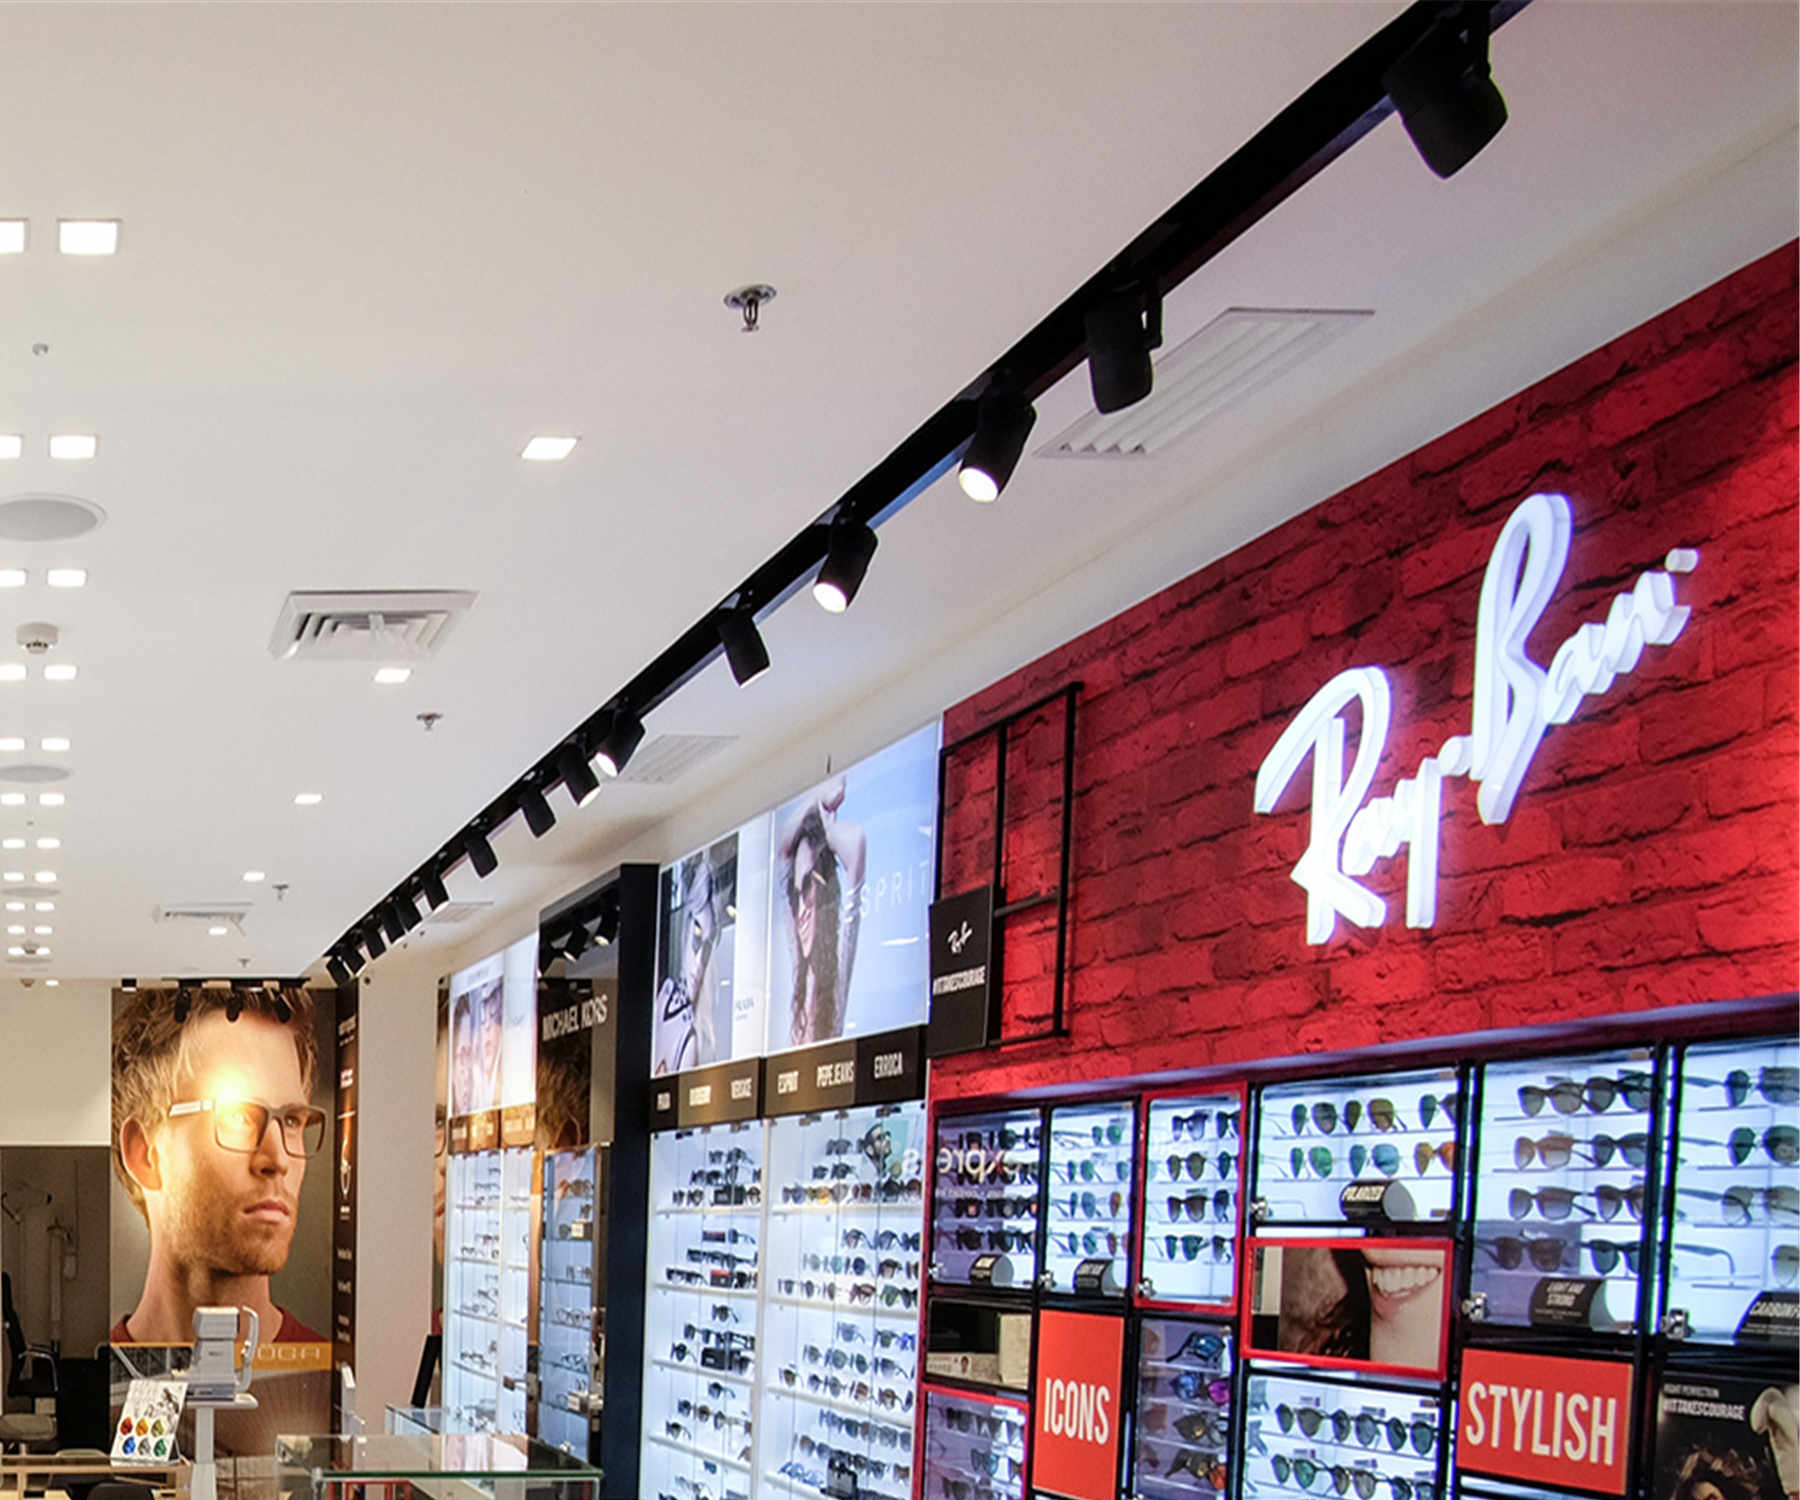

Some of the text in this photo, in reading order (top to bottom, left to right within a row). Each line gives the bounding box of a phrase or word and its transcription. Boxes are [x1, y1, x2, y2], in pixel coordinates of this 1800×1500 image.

[1253, 492, 1694, 946] Ray-Ban
[542, 993, 609, 1041] MICHAEL KORS
[1043, 1377, 1111, 1445] ICONS
[1465, 1381, 1617, 1466] STYLISH
